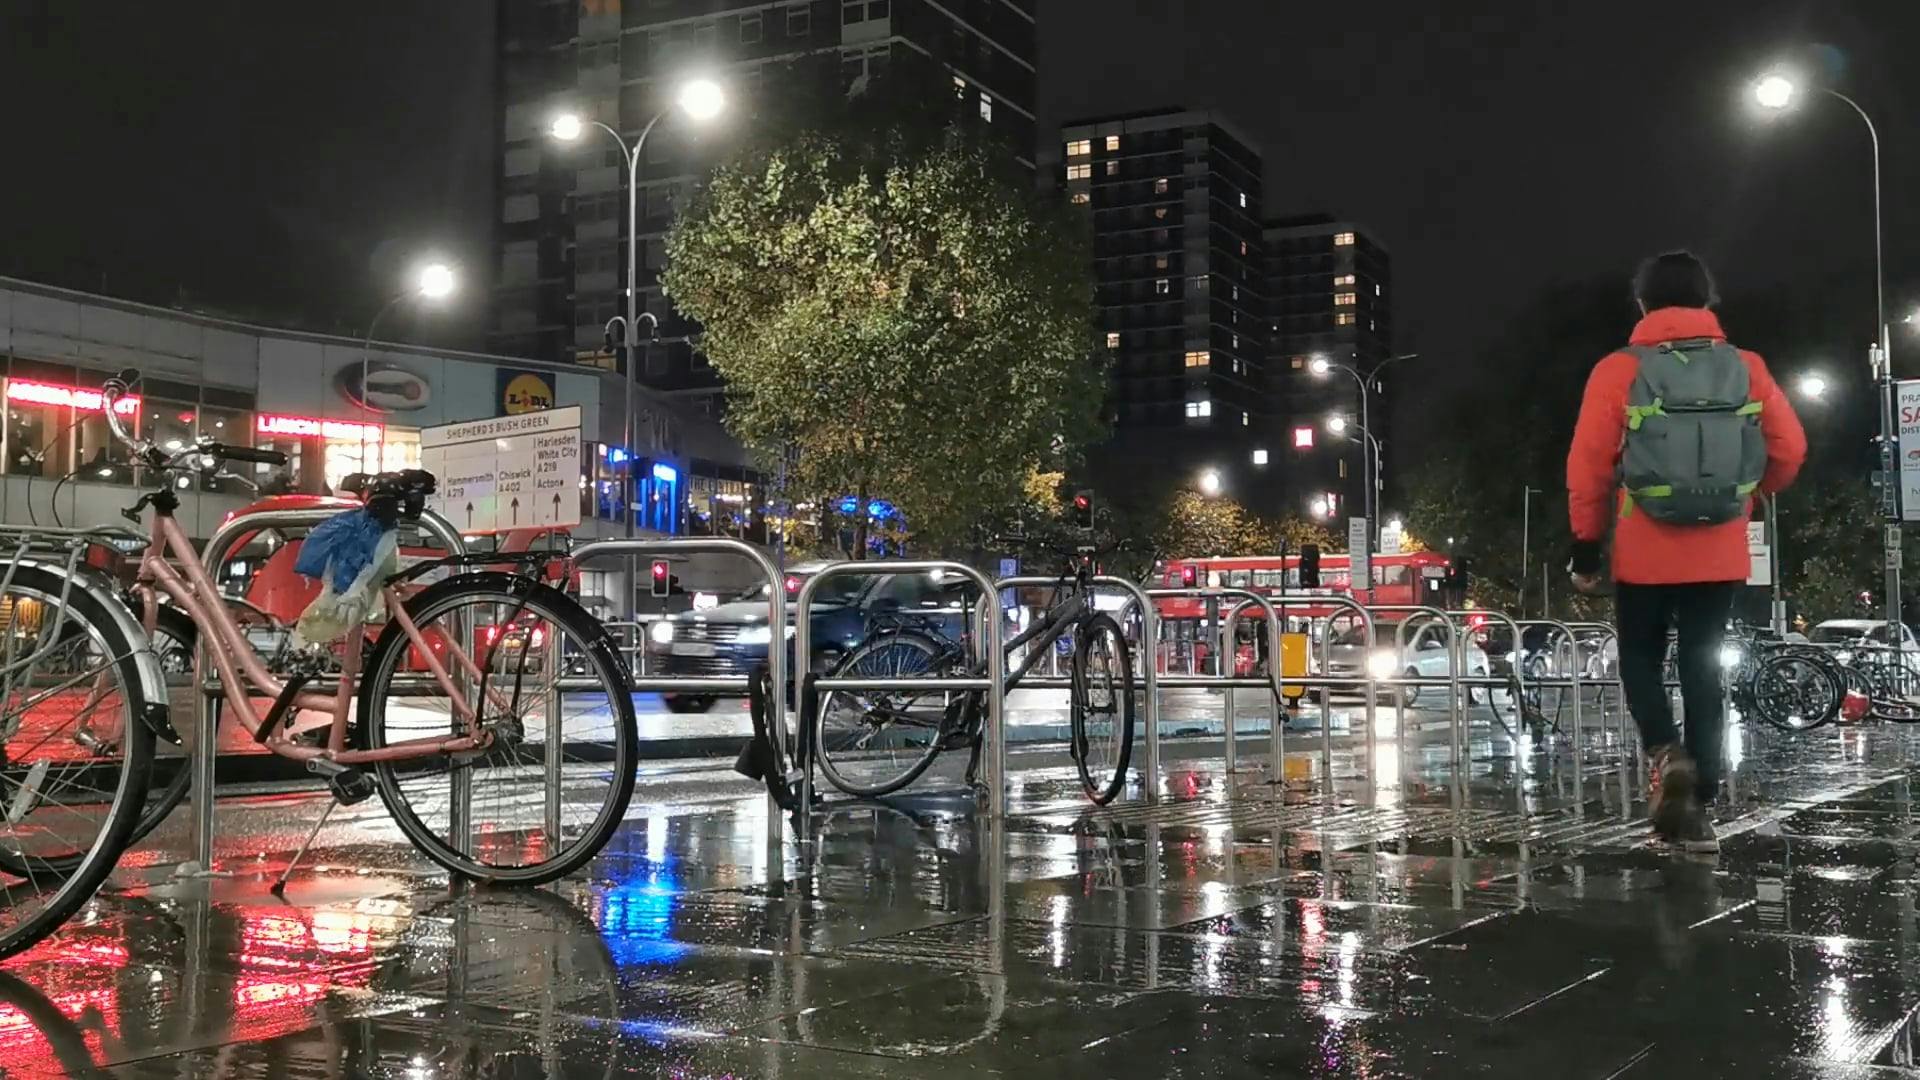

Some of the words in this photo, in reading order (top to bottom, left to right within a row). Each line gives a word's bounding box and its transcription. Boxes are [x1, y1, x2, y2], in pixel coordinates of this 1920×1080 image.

[446, 423, 495, 439] SHEPHERD'S
[496, 420, 519, 432] BUSH
[521, 416, 550, 429] GREEN
[537, 435, 576, 448] Harlesden
[537, 449, 560, 460] White
[561, 446, 578, 458] City
[447, 472, 495, 486] Hammersmith
[499, 468, 531, 481] Chiswick
[537, 479, 560, 489] Acton
